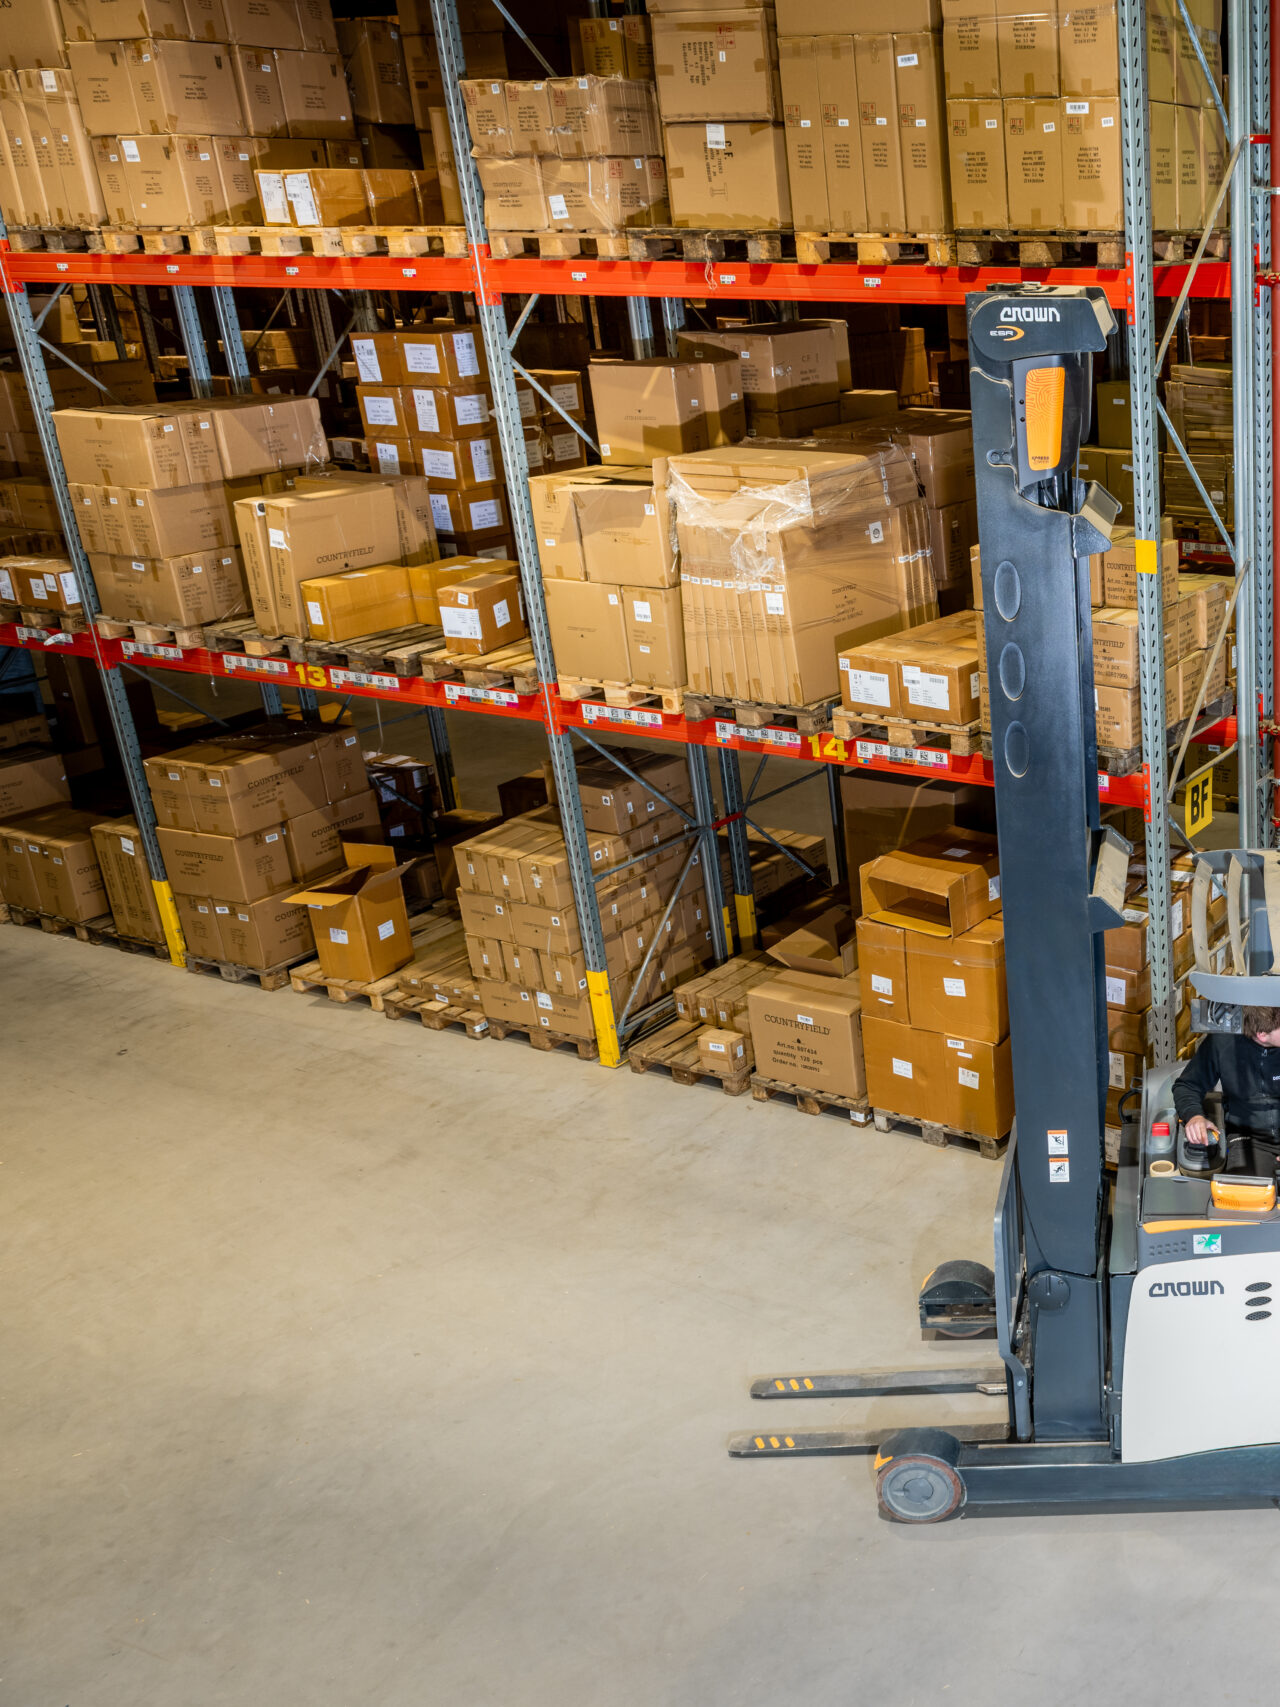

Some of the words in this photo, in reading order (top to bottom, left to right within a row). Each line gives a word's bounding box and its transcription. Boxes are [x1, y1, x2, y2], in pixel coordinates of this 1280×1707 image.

[1000, 307, 1060, 322] CROWN
[317, 546, 375, 563] COUNTRYFIELD
[295, 664, 327, 687] 13
[808, 735, 849, 762] 14
[1190, 777, 1209, 826] BF
[764, 1014, 832, 1036] COUNTRYFIELD
[1149, 1280, 1225, 1297] CROWN
